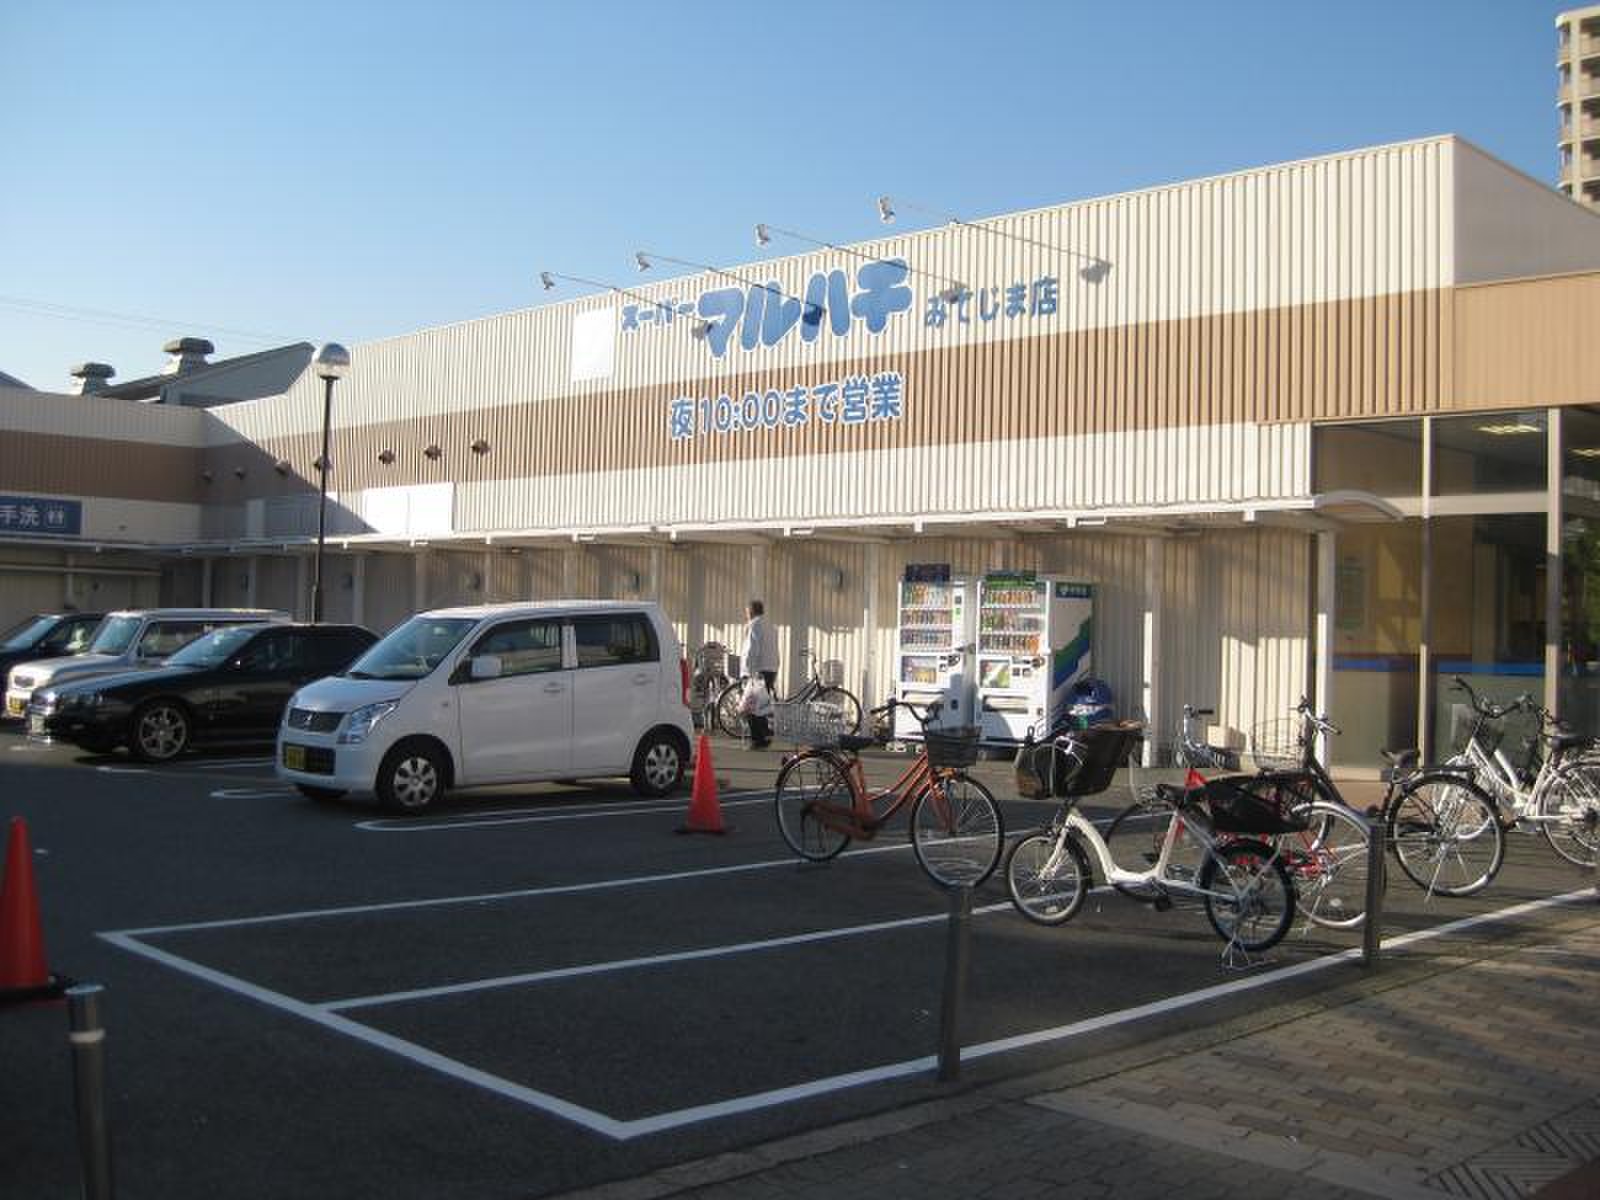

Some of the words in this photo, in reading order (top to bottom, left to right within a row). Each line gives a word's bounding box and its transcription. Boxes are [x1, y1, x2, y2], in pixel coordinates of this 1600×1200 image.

[622, 297, 696, 333] スーパー
[699, 257, 912, 360] マルハチ
[671, 372, 904, 439] 夜10:00まで営業
